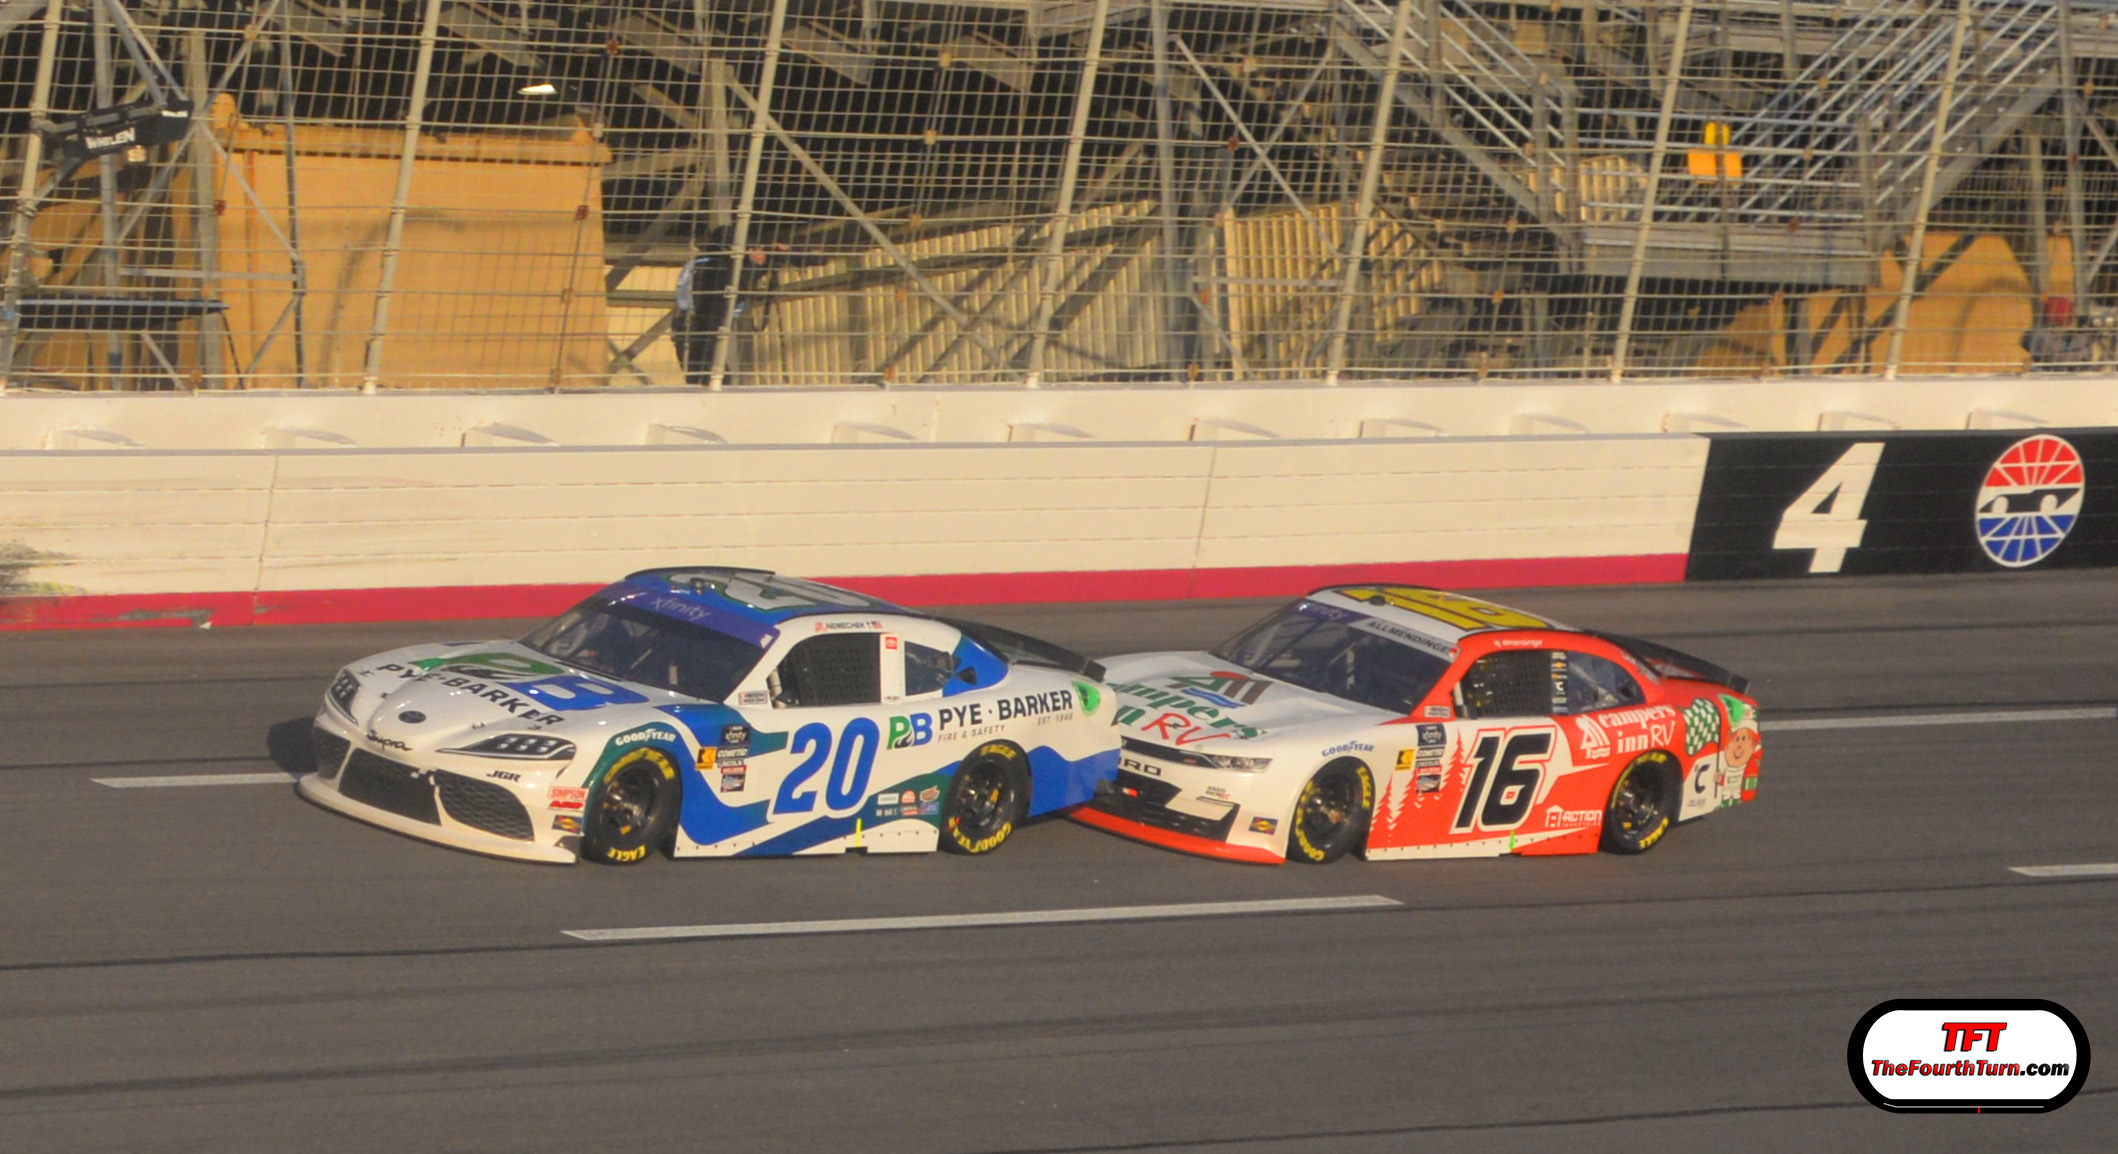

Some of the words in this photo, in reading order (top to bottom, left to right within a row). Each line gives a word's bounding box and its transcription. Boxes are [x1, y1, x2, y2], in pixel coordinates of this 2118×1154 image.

[1772, 442, 1886, 573] 4
[653, 597, 711, 621] xfinity
[1367, 621, 1456, 656] ALLMENDINGE
[939, 703, 983, 731] PYE
[998, 689, 1073, 721] BARKER
[1598, 705, 1677, 730] campers
[366, 729, 412, 752] Supra
[938, 732, 958, 743] FIRE
[971, 724, 1007, 739] SAFETY
[1617, 730, 1649, 754] inn
[1650, 720, 1676, 748] RV
[486, 769, 522, 783] JGR
[773, 717, 881, 817] 20
[1453, 730, 1557, 831] 16
[1562, 809, 1602, 823] ACTION
[607, 844, 647, 862] EAGLE
